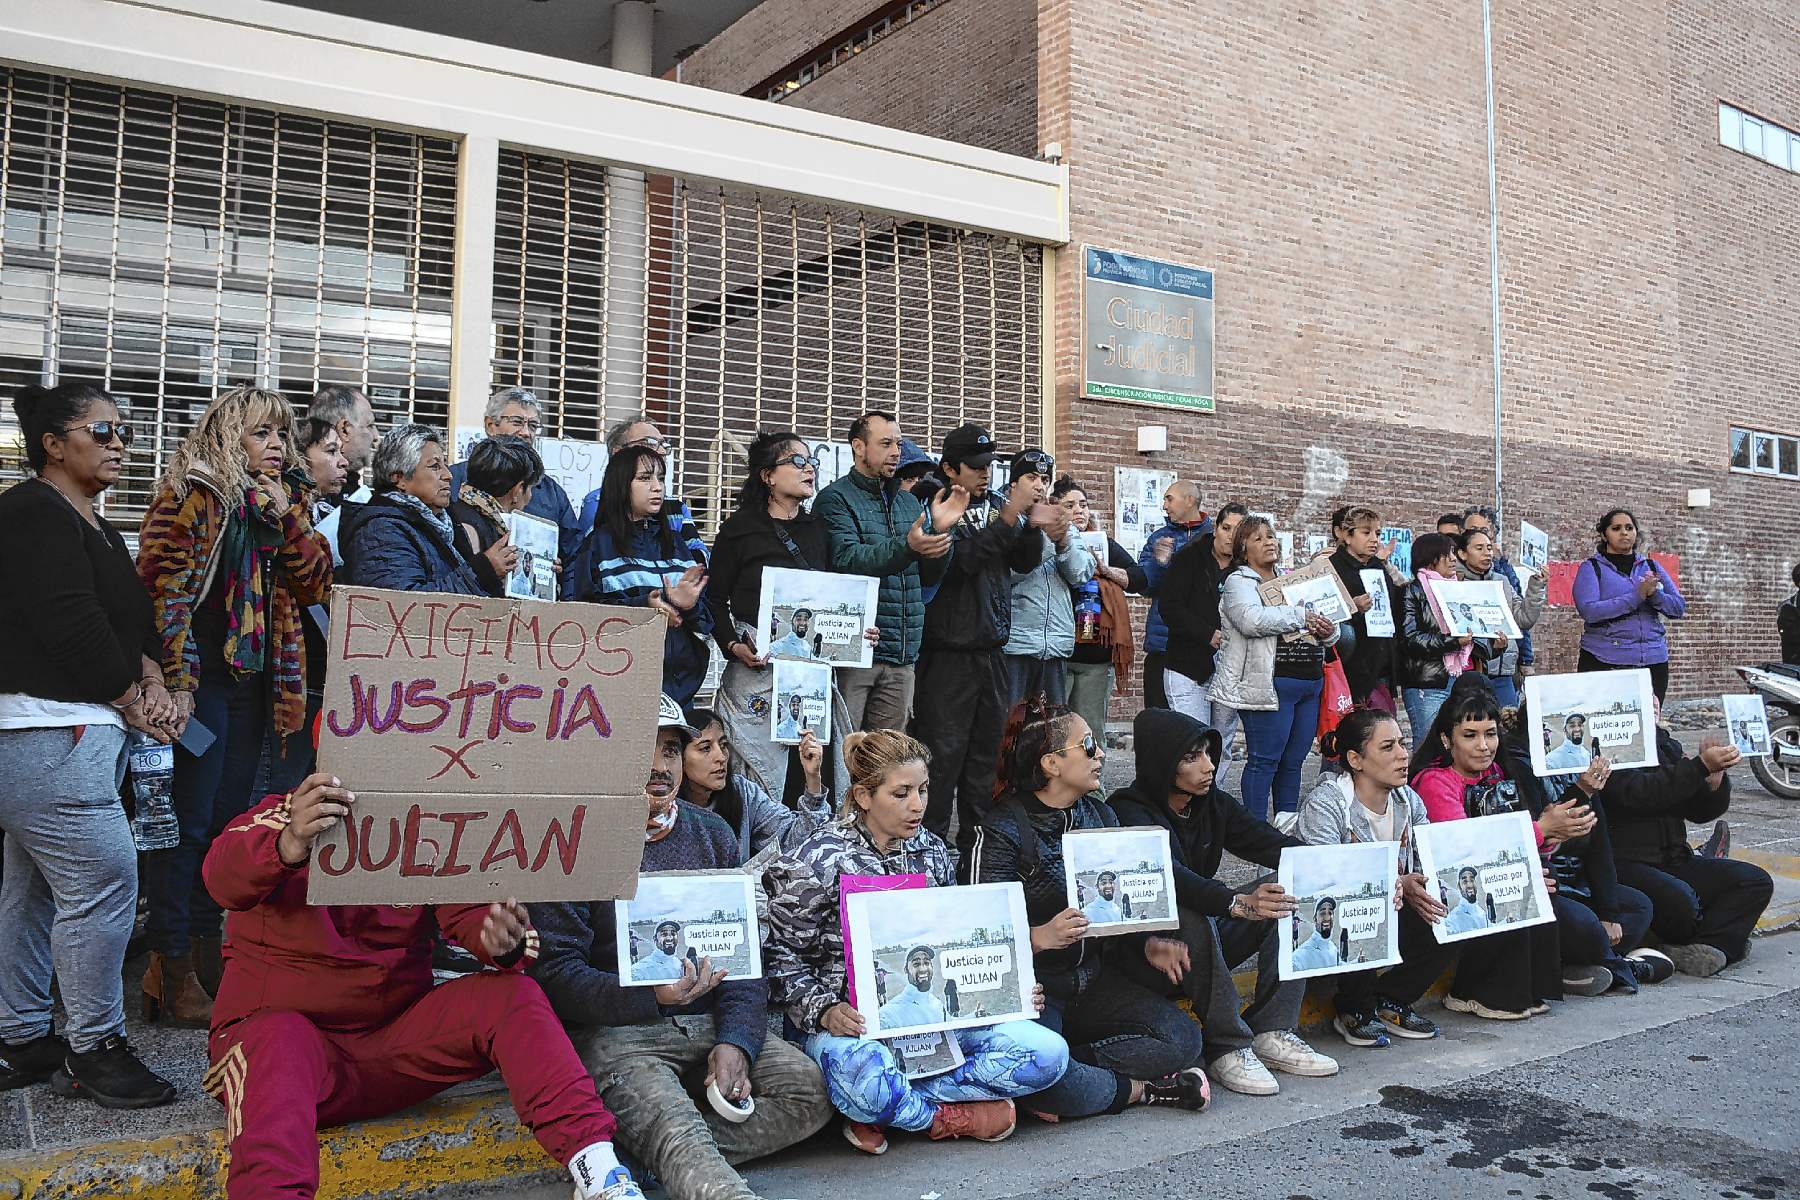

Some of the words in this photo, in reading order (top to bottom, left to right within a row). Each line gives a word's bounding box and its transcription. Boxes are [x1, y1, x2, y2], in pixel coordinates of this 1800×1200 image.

[1107, 297, 1194, 340] Ciudad
[1104, 335, 1195, 377] Judicial
[817, 619, 842, 628] Justicia
[844, 621, 855, 629] por
[825, 631, 849, 641] JULIAN
[343, 594, 633, 690] EXIGIMOS
[327, 673, 612, 741] JUSTICIA
[1592, 720, 1619, 729] Justicia
[1621, 720, 1634, 729] por
[1602, 731, 1629, 741] JULIAN
[1510, 871, 1522, 881] por
[1132, 890, 1155, 899] JULIAN
[1495, 885, 1520, 898] JULIAN
[1342, 906, 1368, 918] Justicia
[1369, 906, 1381, 917] por
[1351, 921, 1376, 934] JULIAN
[688, 929, 720, 939] Justicia
[722, 930, 737, 939] por
[700, 942, 731, 953] JULIAN
[945, 953, 984, 968] Justicia
[987, 954, 1004, 967] por
[960, 971, 998, 986] JULIAN
[905, 1042, 932, 1053] JULIAN
